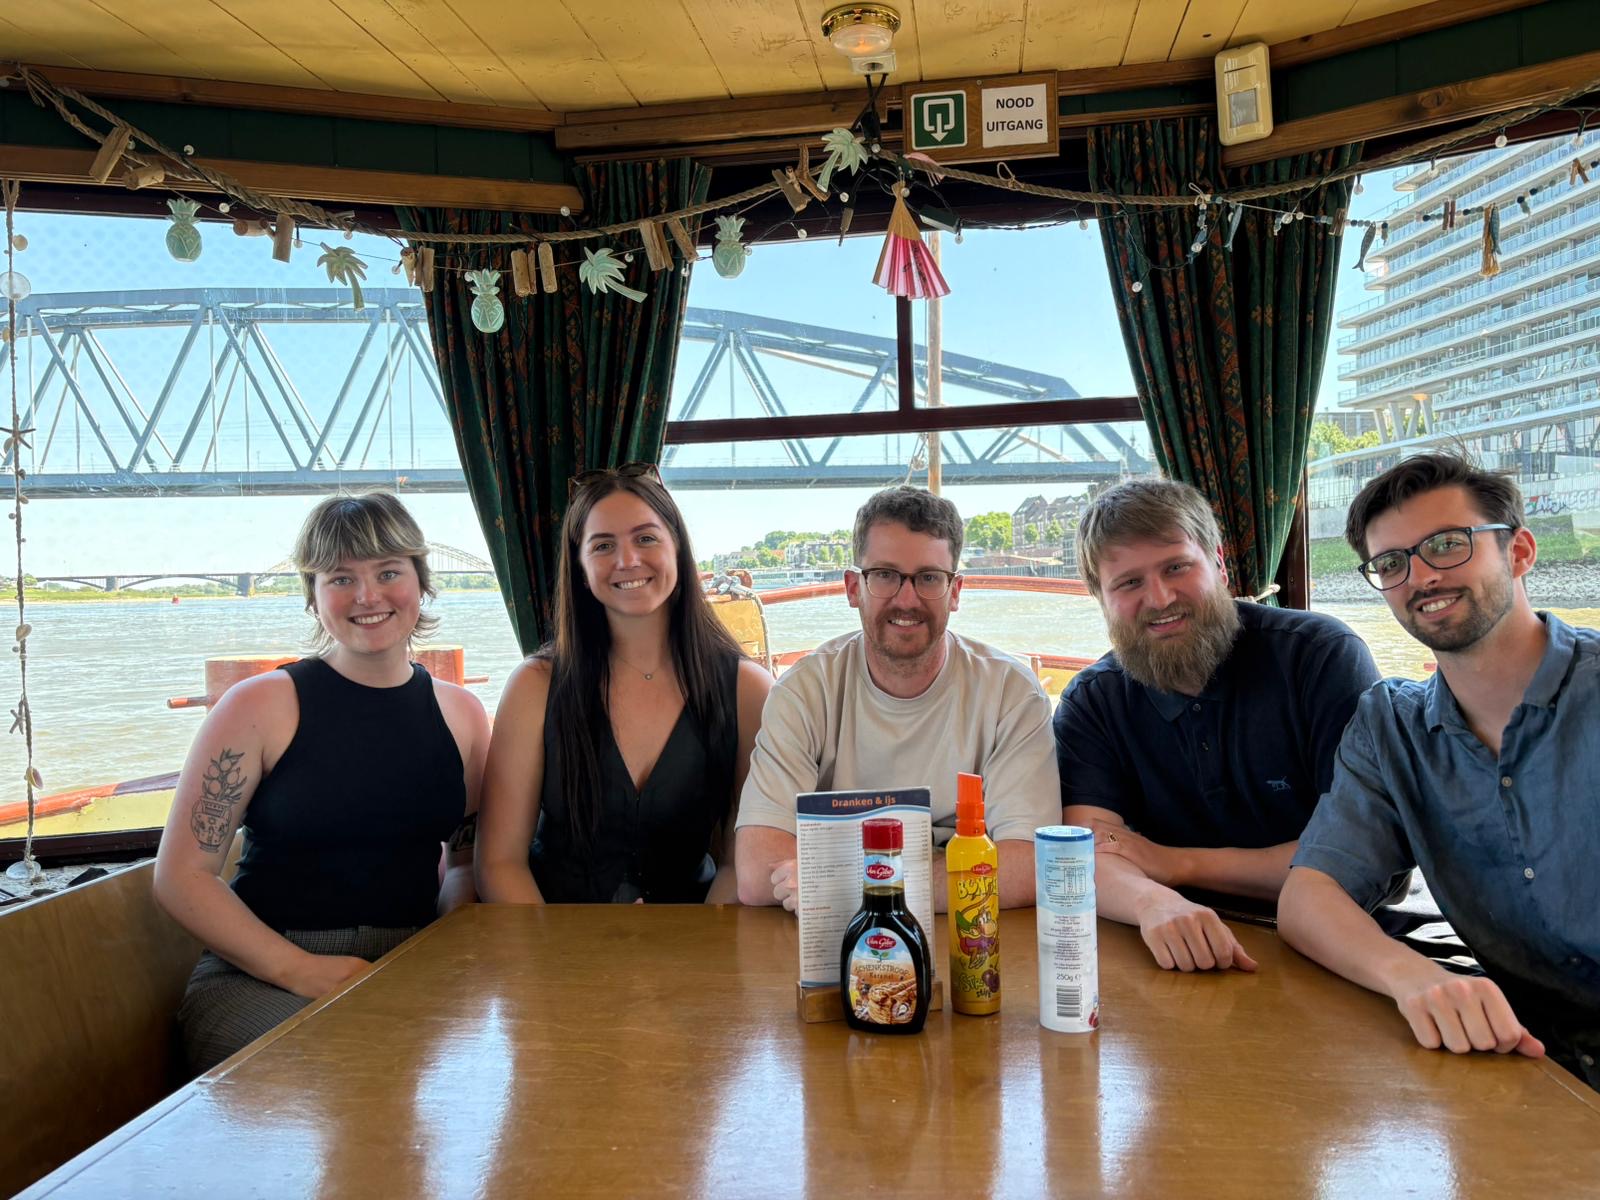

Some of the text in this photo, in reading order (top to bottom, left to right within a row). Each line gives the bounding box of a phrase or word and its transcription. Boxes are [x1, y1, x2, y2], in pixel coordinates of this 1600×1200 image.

[996, 97, 1034, 109] NOOD
[986, 118, 1043, 132] UITGANG
[831, 797, 873, 808] Dranken
[875, 796, 883, 805] &
[866, 866, 876, 874] Van
[866, 935, 878, 945] Van
[1056, 973, 1074, 982] 250g
